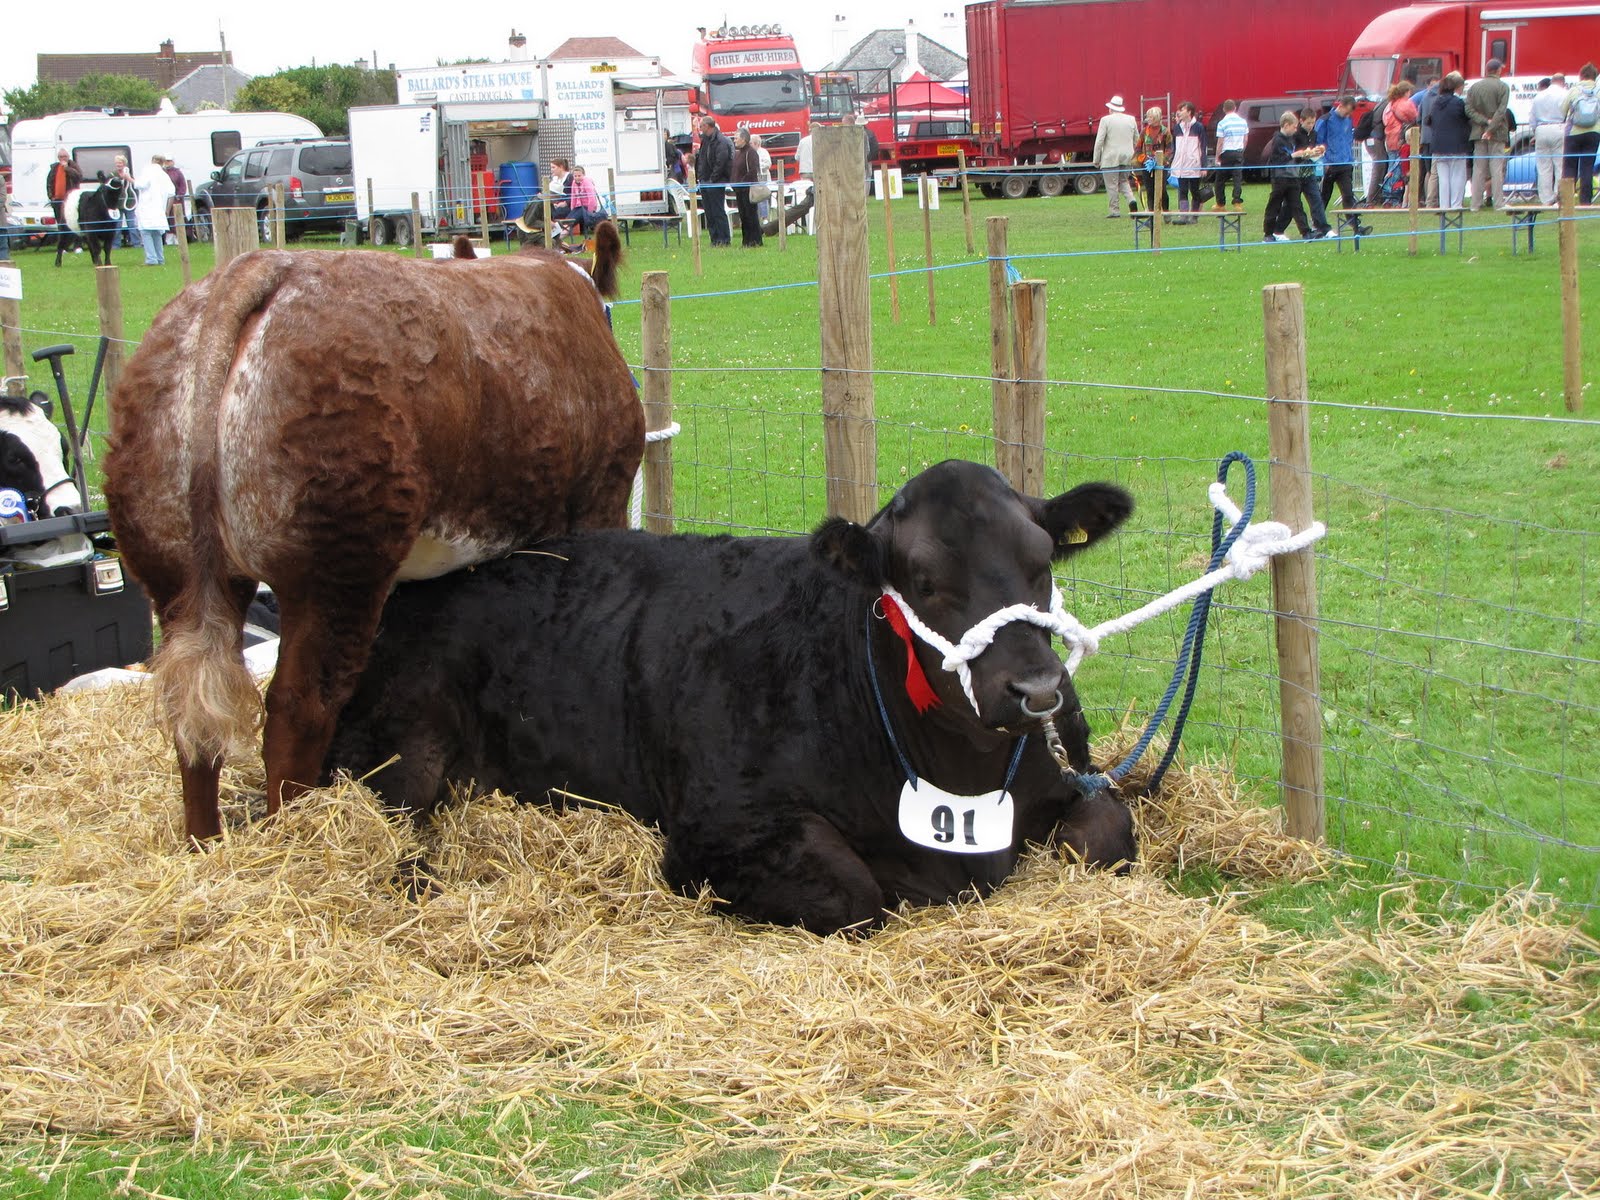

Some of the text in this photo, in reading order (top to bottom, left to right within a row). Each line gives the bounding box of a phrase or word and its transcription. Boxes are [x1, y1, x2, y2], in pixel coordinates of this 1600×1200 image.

[713, 54, 740, 65] SHIRE
[732, 70, 782, 78] SCOTLAND
[407, 71, 532, 92] BALLARD'S STEAK HOUSE
[556, 80, 605, 89] BALLARD'S
[449, 90, 513, 101] CASTLE DOUGLAS
[557, 91, 604, 100] CATERING
[736, 119, 785, 129] Glenluce
[930, 804, 978, 846] 91
